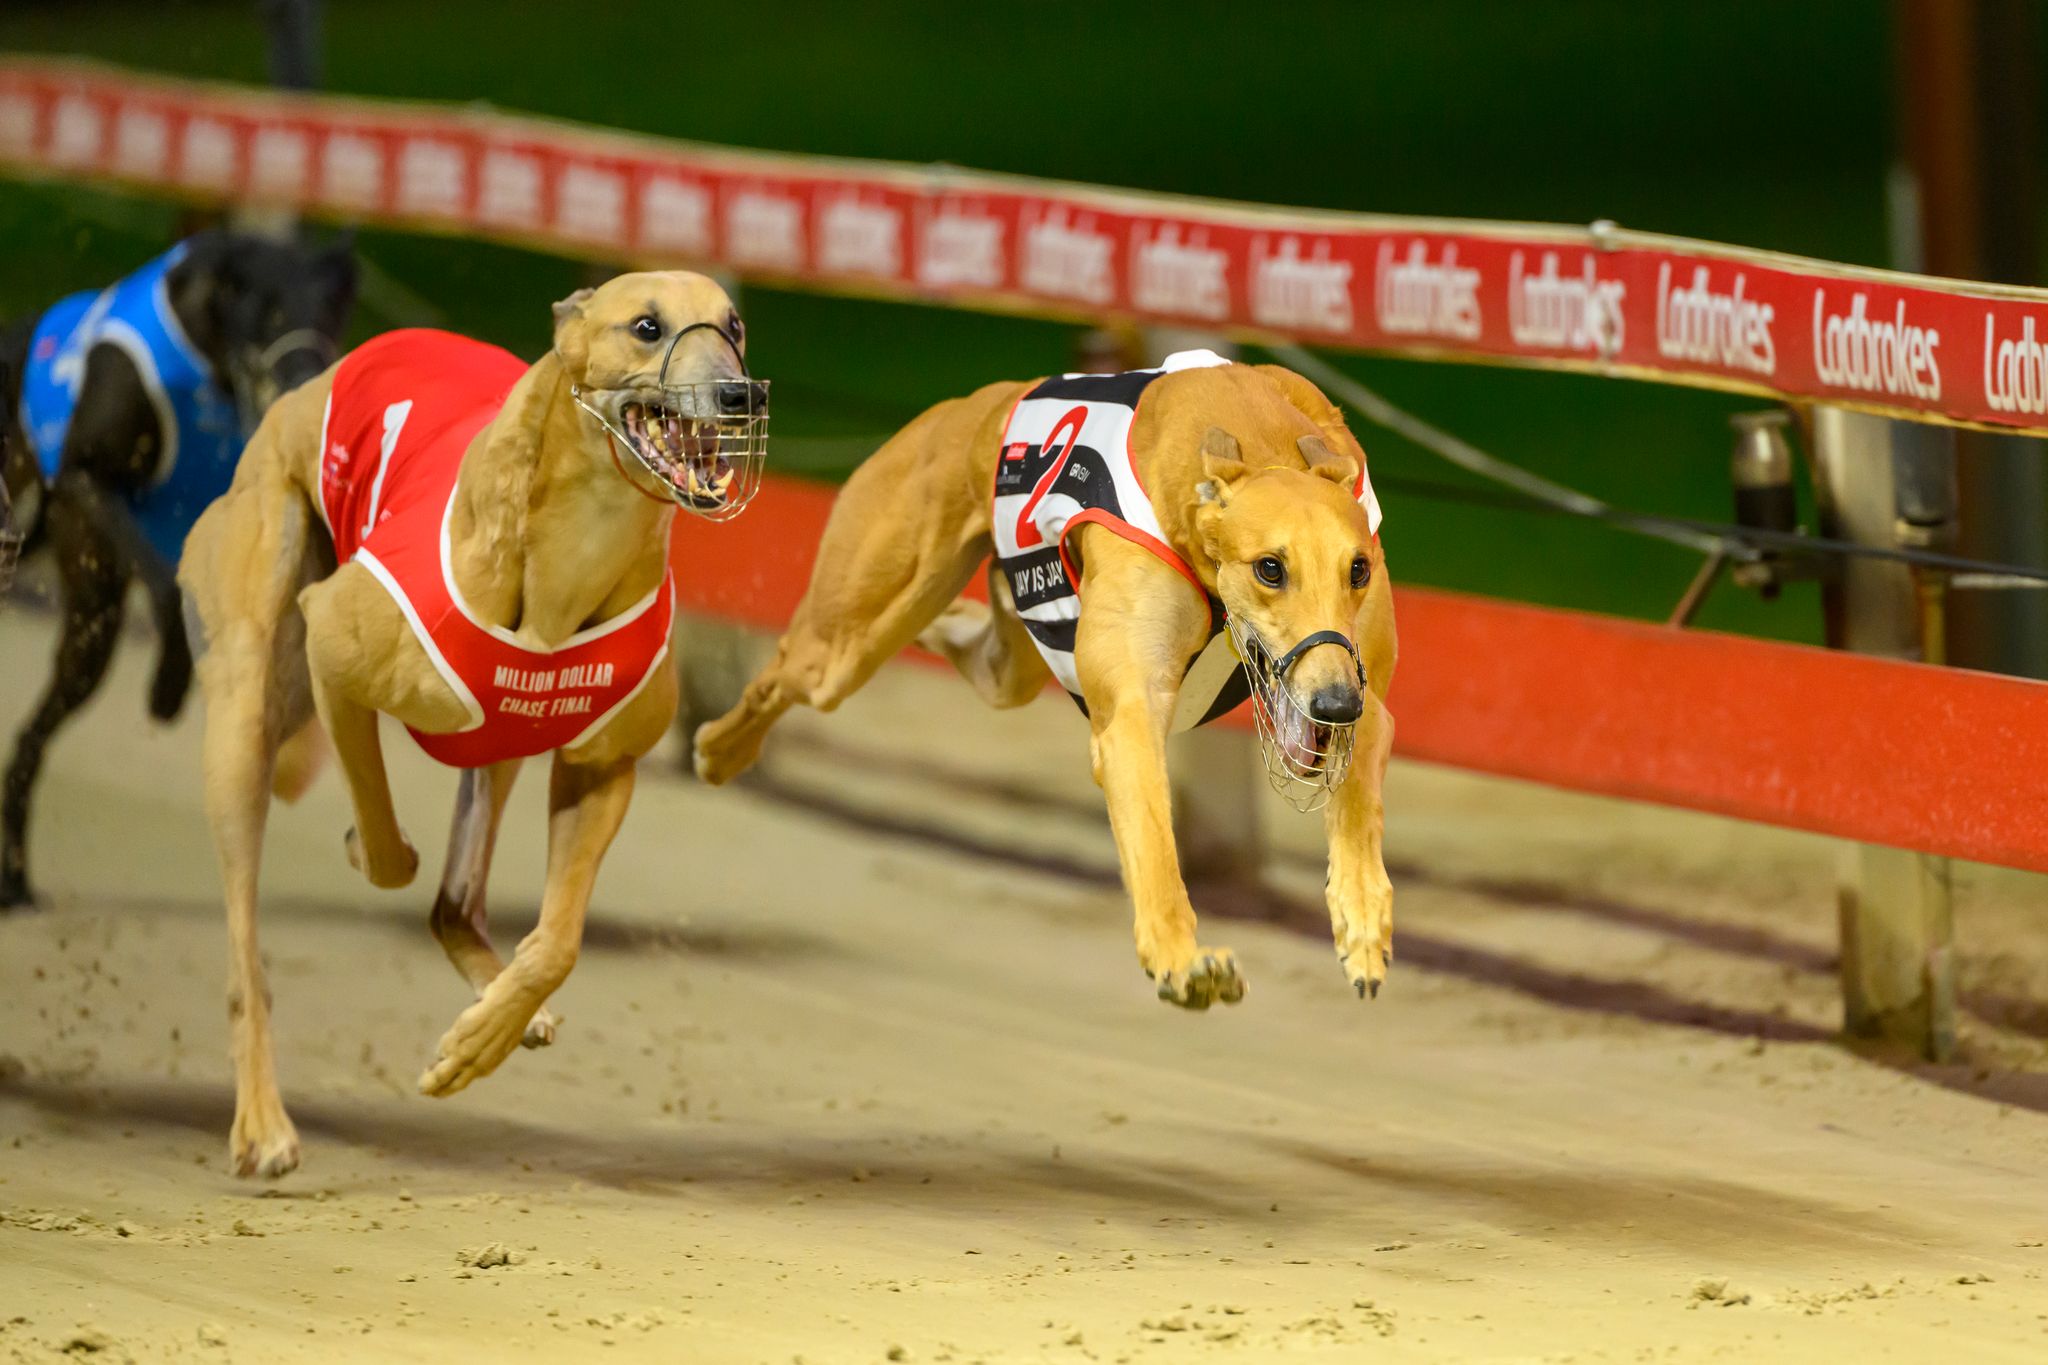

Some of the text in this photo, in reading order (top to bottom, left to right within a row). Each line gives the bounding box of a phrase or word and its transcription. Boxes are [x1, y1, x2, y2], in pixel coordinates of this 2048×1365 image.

[1657, 260, 1775, 376] Ladbrokes
[1813, 287, 1941, 401] Ladbrokes
[1015, 405, 1089, 550] 2
[1031, 565, 1045, 592] IS
[1045, 559, 1064, 588] JAY
[493, 662, 614, 693] MILLION DOLLAR
[498, 695, 592, 719] CHASE FINAL
